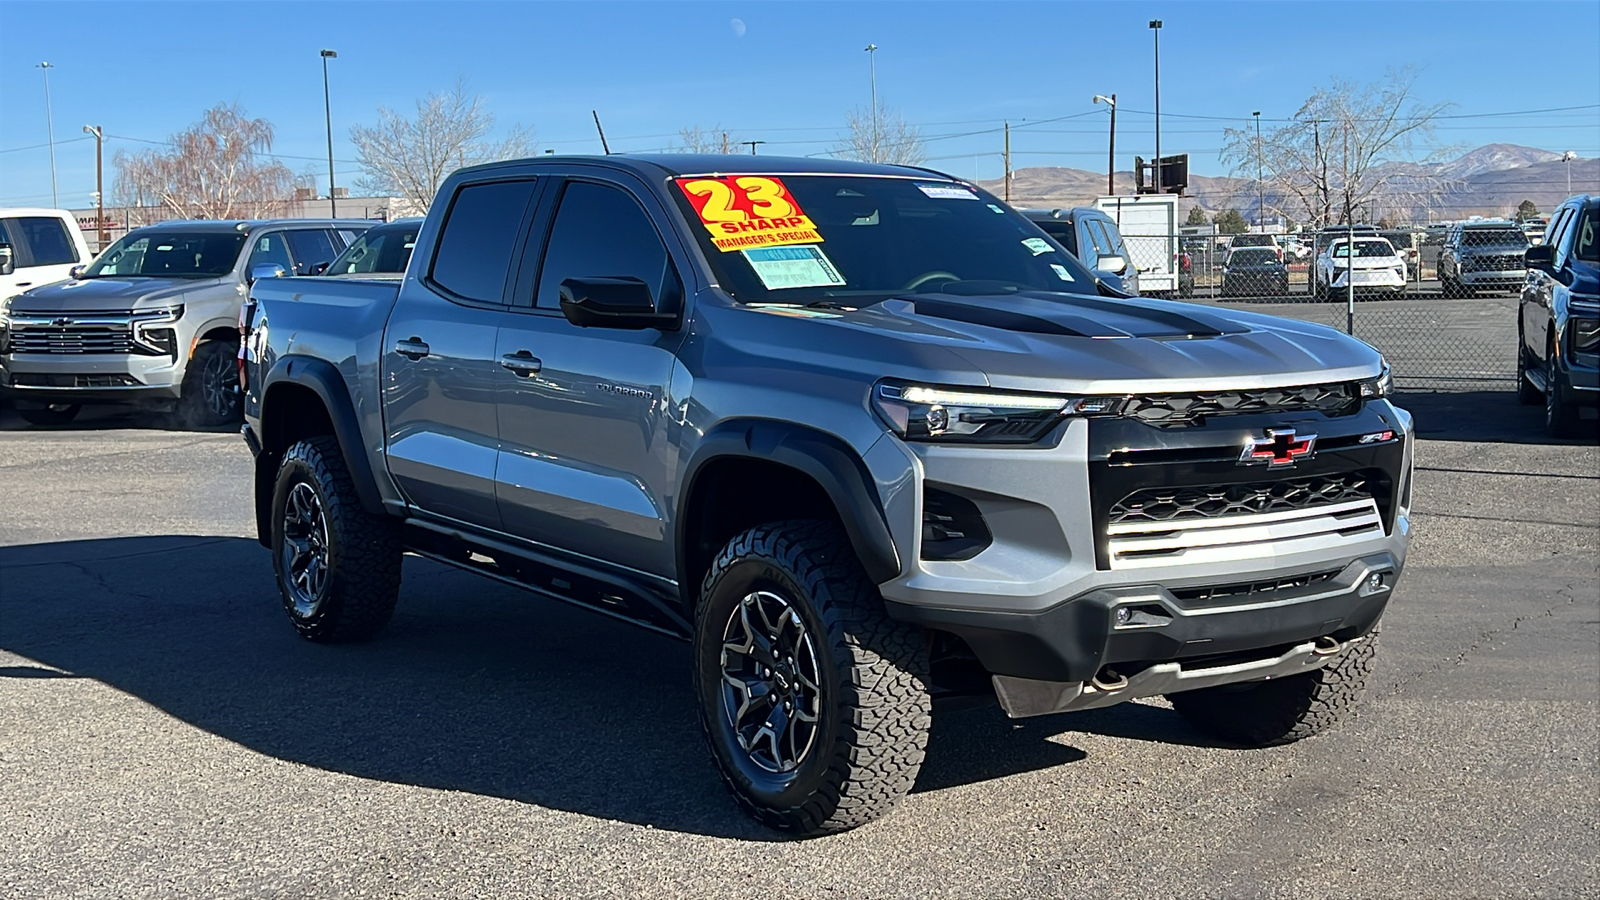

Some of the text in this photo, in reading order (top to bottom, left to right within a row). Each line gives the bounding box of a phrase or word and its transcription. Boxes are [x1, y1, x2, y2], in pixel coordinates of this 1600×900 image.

[684, 176, 796, 222] 23
[720, 217, 804, 234] SHARP
[715, 230, 817, 249] MANAGER'S SPECIAL
[596, 382, 653, 400] COLORADO
